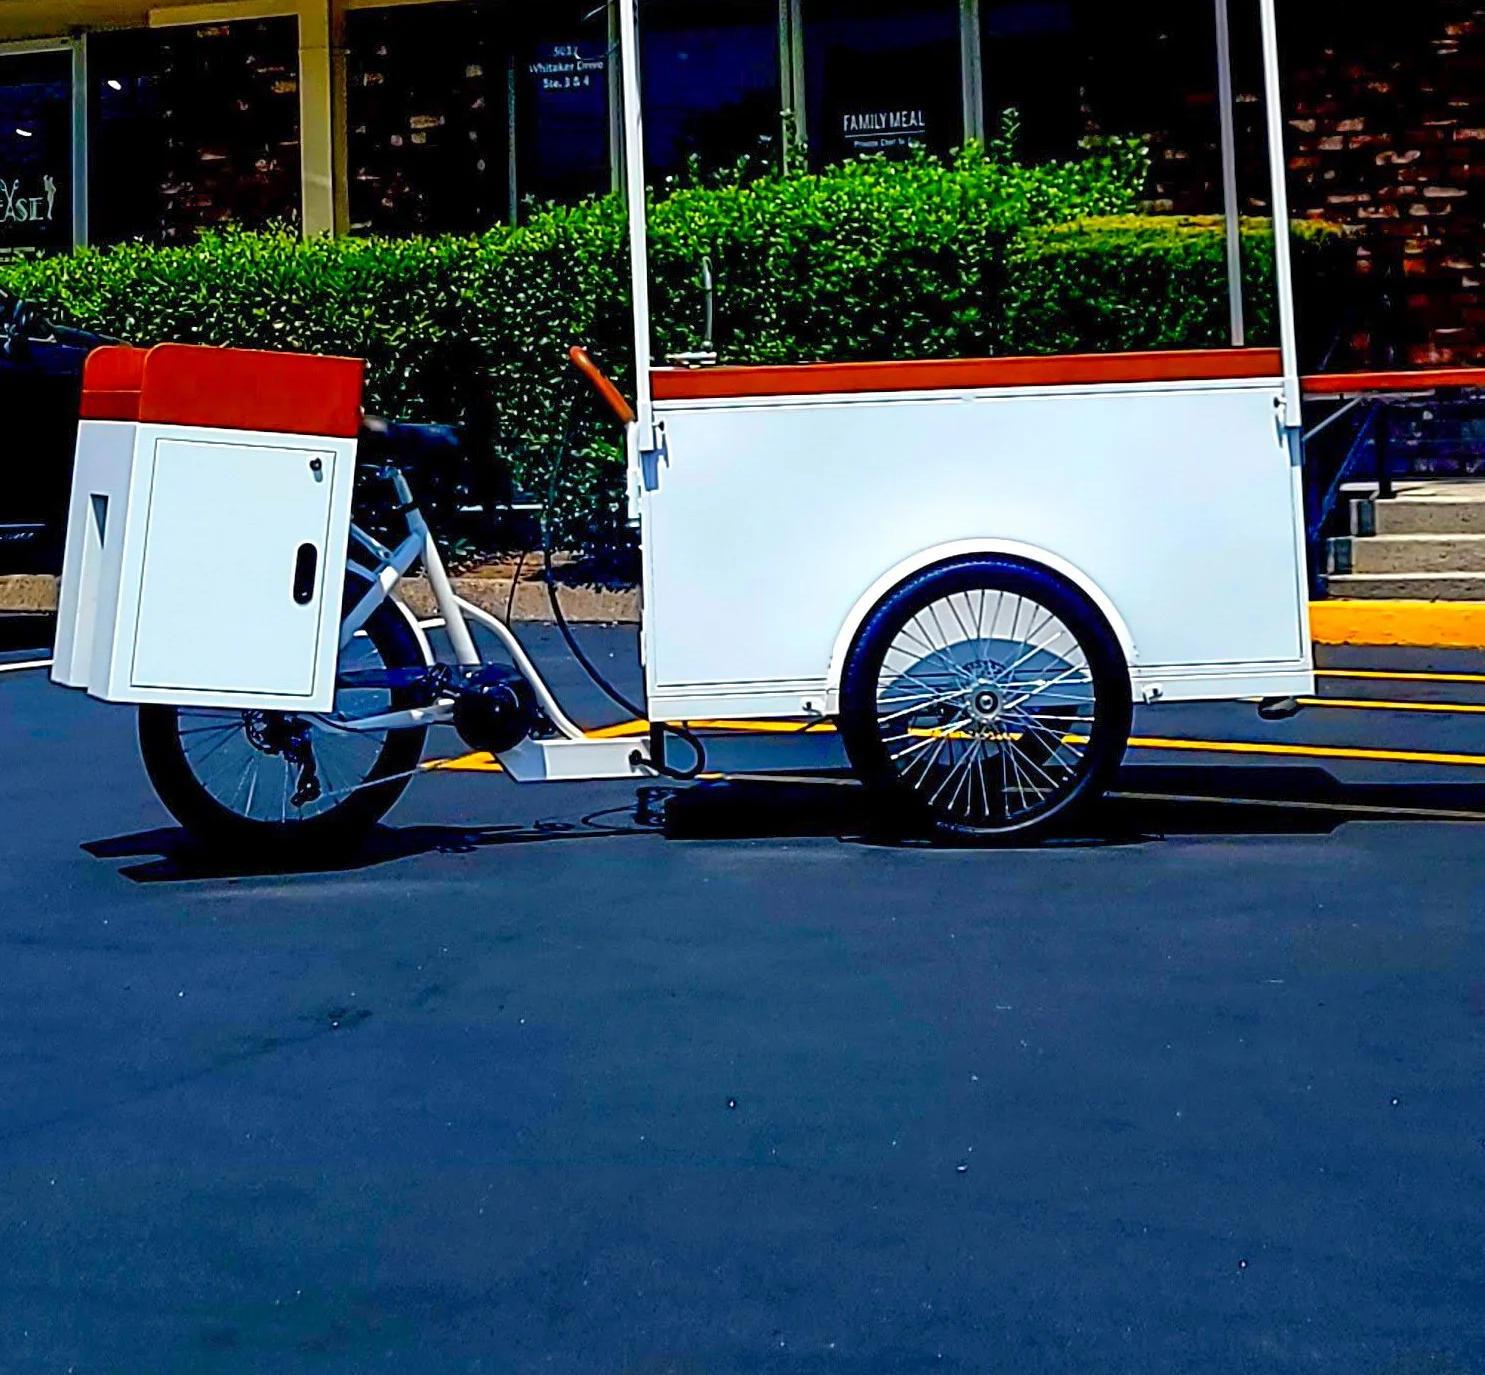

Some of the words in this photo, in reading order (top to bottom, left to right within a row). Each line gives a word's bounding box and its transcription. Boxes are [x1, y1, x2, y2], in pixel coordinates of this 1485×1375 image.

[529, 61, 574, 73] Whitaker
[577, 61, 604, 71] Drive
[564, 76, 570, 87] 3
[583, 74, 589, 85] 4
[843, 113, 888, 131] FAMILY
[889, 110, 925, 127] MEAL
